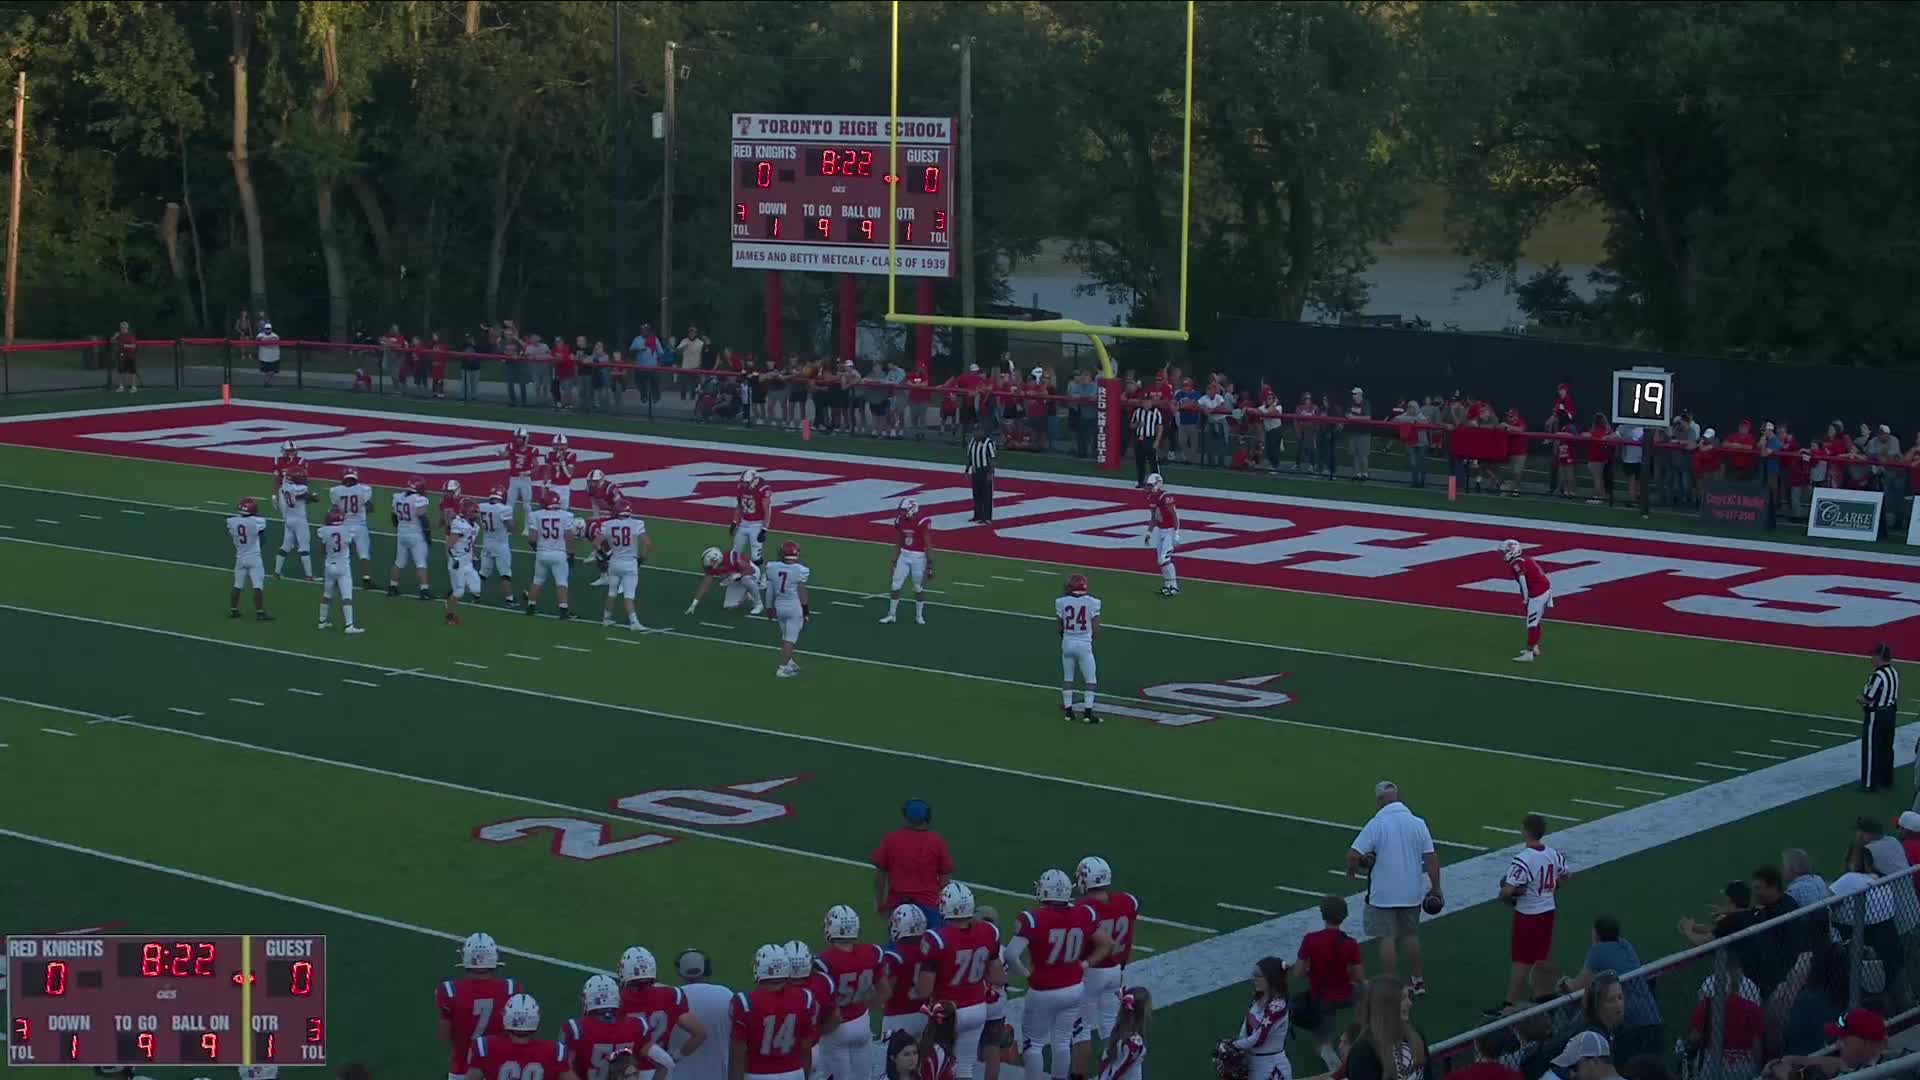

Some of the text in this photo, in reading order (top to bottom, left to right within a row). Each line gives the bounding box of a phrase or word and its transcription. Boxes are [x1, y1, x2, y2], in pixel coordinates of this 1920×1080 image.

[759, 119, 946, 138] TORONTO HIGH SCHOOL
[733, 145, 797, 160] RED KNIGHTS
[906, 149, 940, 163] GUEST
[822, 150, 873, 176] 8:22
[757, 162, 772, 188] 0
[924, 167, 940, 193] 0
[758, 202, 787, 216] DOWN
[803, 204, 832, 217] TO GO
[841, 205, 881, 219] BALL ON
[896, 207, 915, 221] QTR
[734, 224, 750, 236] TOL
[818, 218, 829, 239] 9
[862, 219, 873, 239] 9
[930, 231, 948, 243] TOL
[735, 251, 946, 270] JAMES AND BETTY METCALF CLAS OF 1939
[1632, 382, 1663, 415] 19
[1097, 387, 1107, 463] RED KNIGHTS
[341, 495, 359, 514] 78
[396, 503, 412, 521] 59
[1818, 500, 1873, 525] CLARKE
[237, 524, 247, 544] 9
[541, 518, 560, 539] 55
[611, 526, 631, 546] 58
[331, 532, 341, 552] 3
[778, 571, 788, 593] 7
[1064, 605, 1087, 630] 24
[474, 788, 792, 860] 20
[1537, 864, 1554, 896] 14
[1048, 928, 1083, 965] 70
[472, 998, 494, 1035] 7
[762, 1014, 798, 1056] 14
